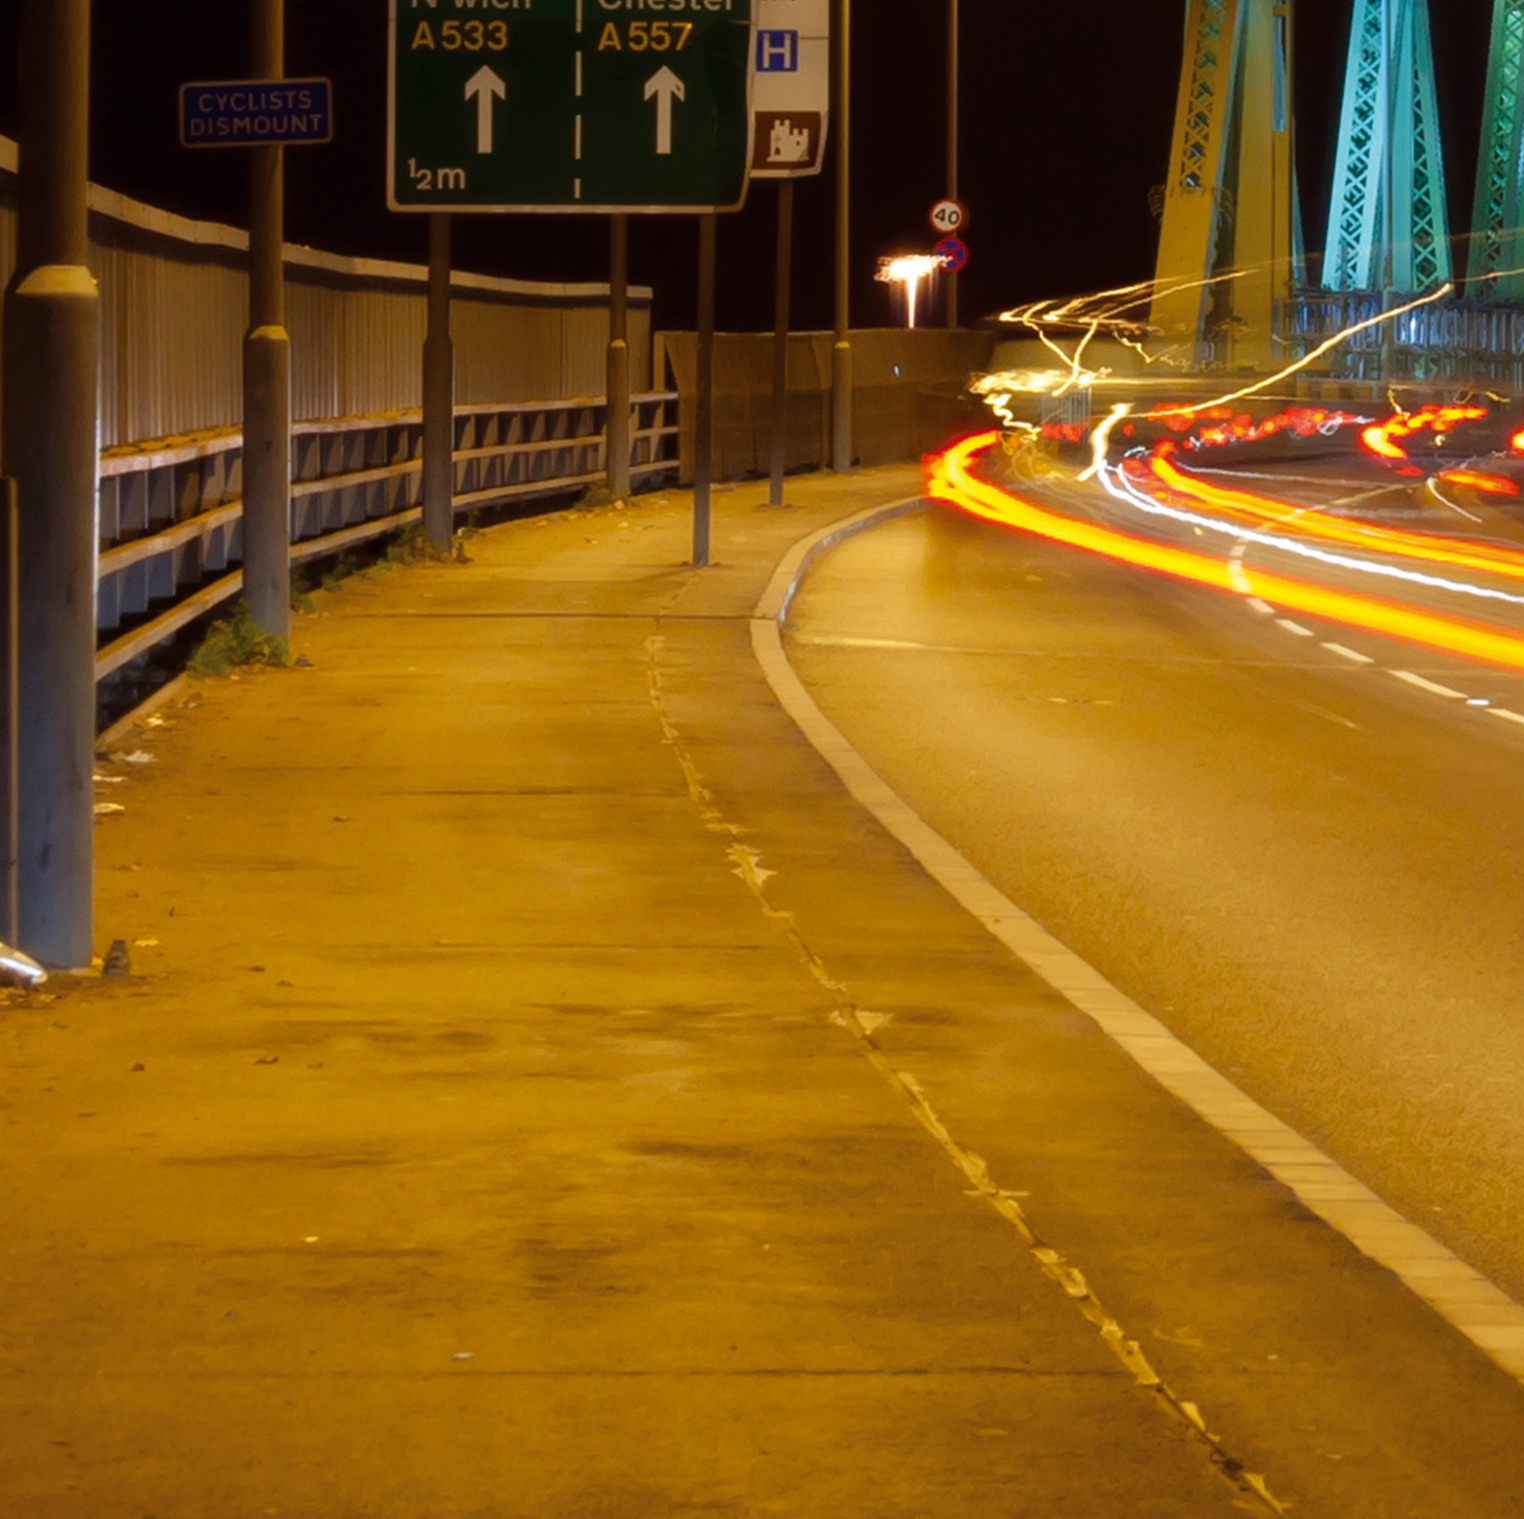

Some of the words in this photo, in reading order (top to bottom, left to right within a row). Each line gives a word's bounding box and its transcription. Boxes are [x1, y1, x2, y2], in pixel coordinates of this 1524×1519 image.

[411, 20, 508, 51] A533
[598, 21, 693, 51] A557
[762, 32, 791, 68] H
[198, 91, 312, 112] CYCLISTS
[190, 114, 322, 136] DISMOUNT
[934, 208, 960, 225] 40
